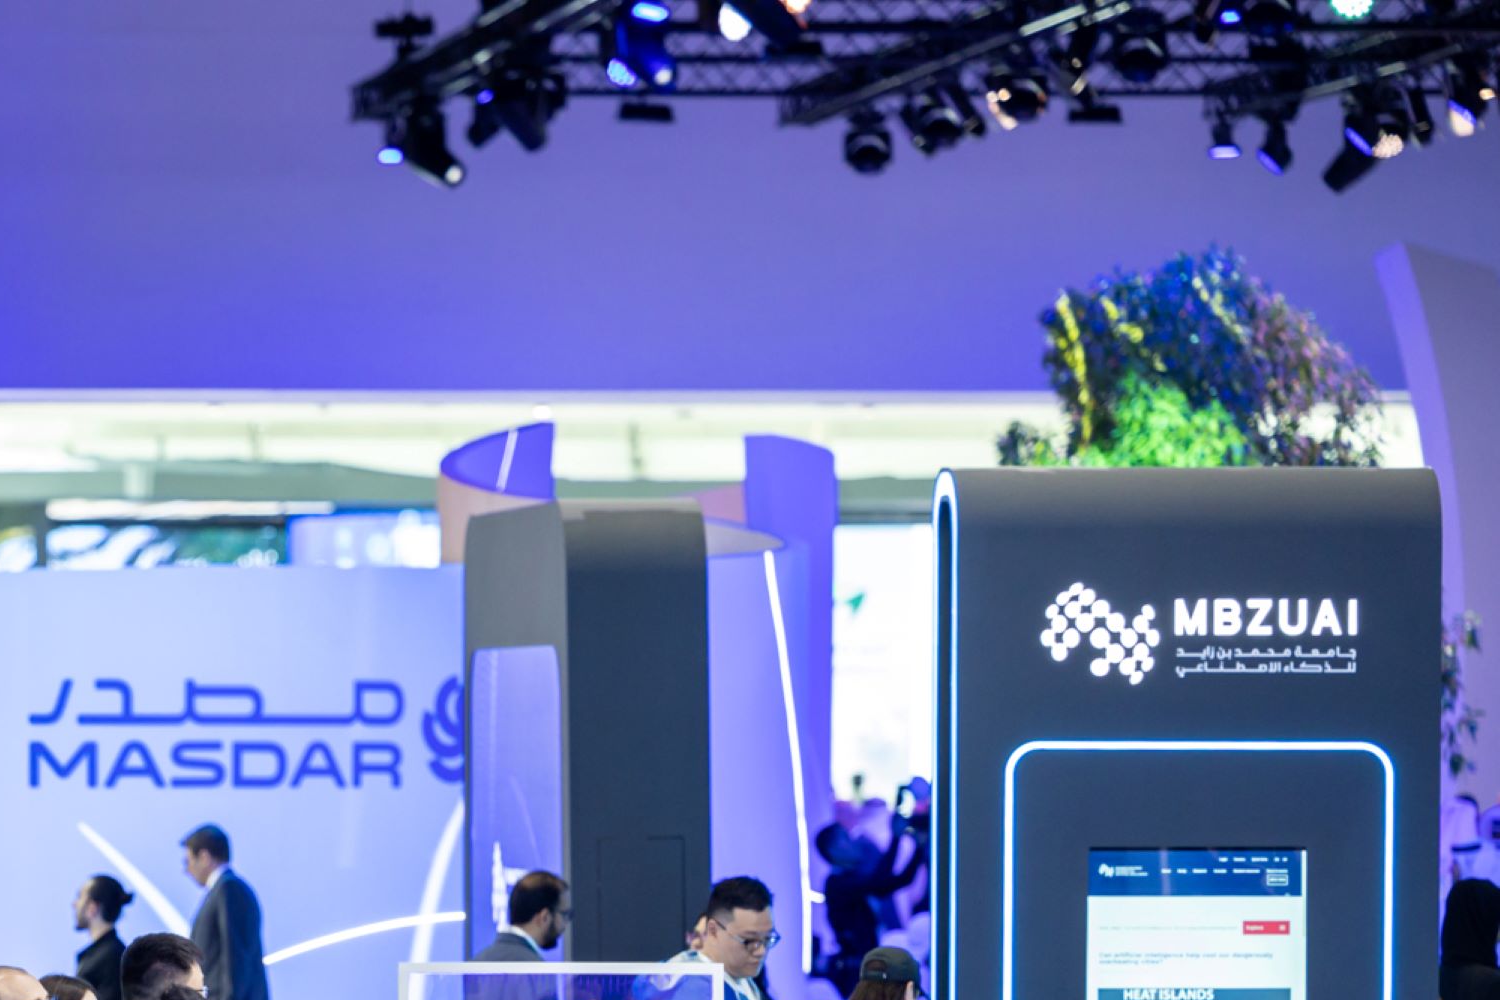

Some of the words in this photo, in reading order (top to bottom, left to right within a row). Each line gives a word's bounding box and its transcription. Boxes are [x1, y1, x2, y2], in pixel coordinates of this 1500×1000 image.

[1173, 598, 1359, 637] MBZUAI
[1175, 645, 1216, 660] زايد
[1216, 646, 1232, 660] بن
[1233, 646, 1292, 658] محمد
[1294, 645, 1358, 660] جامعة
[1175, 661, 1282, 679] الاصطناعي
[1283, 661, 1358, 674] للذكاء
[28, 678, 405, 726] مصدر
[28, 740, 403, 789] MASDAR
[1123, 988, 1156, 1000] HEAT
[1158, 988, 1215, 1000] ISLANDS
